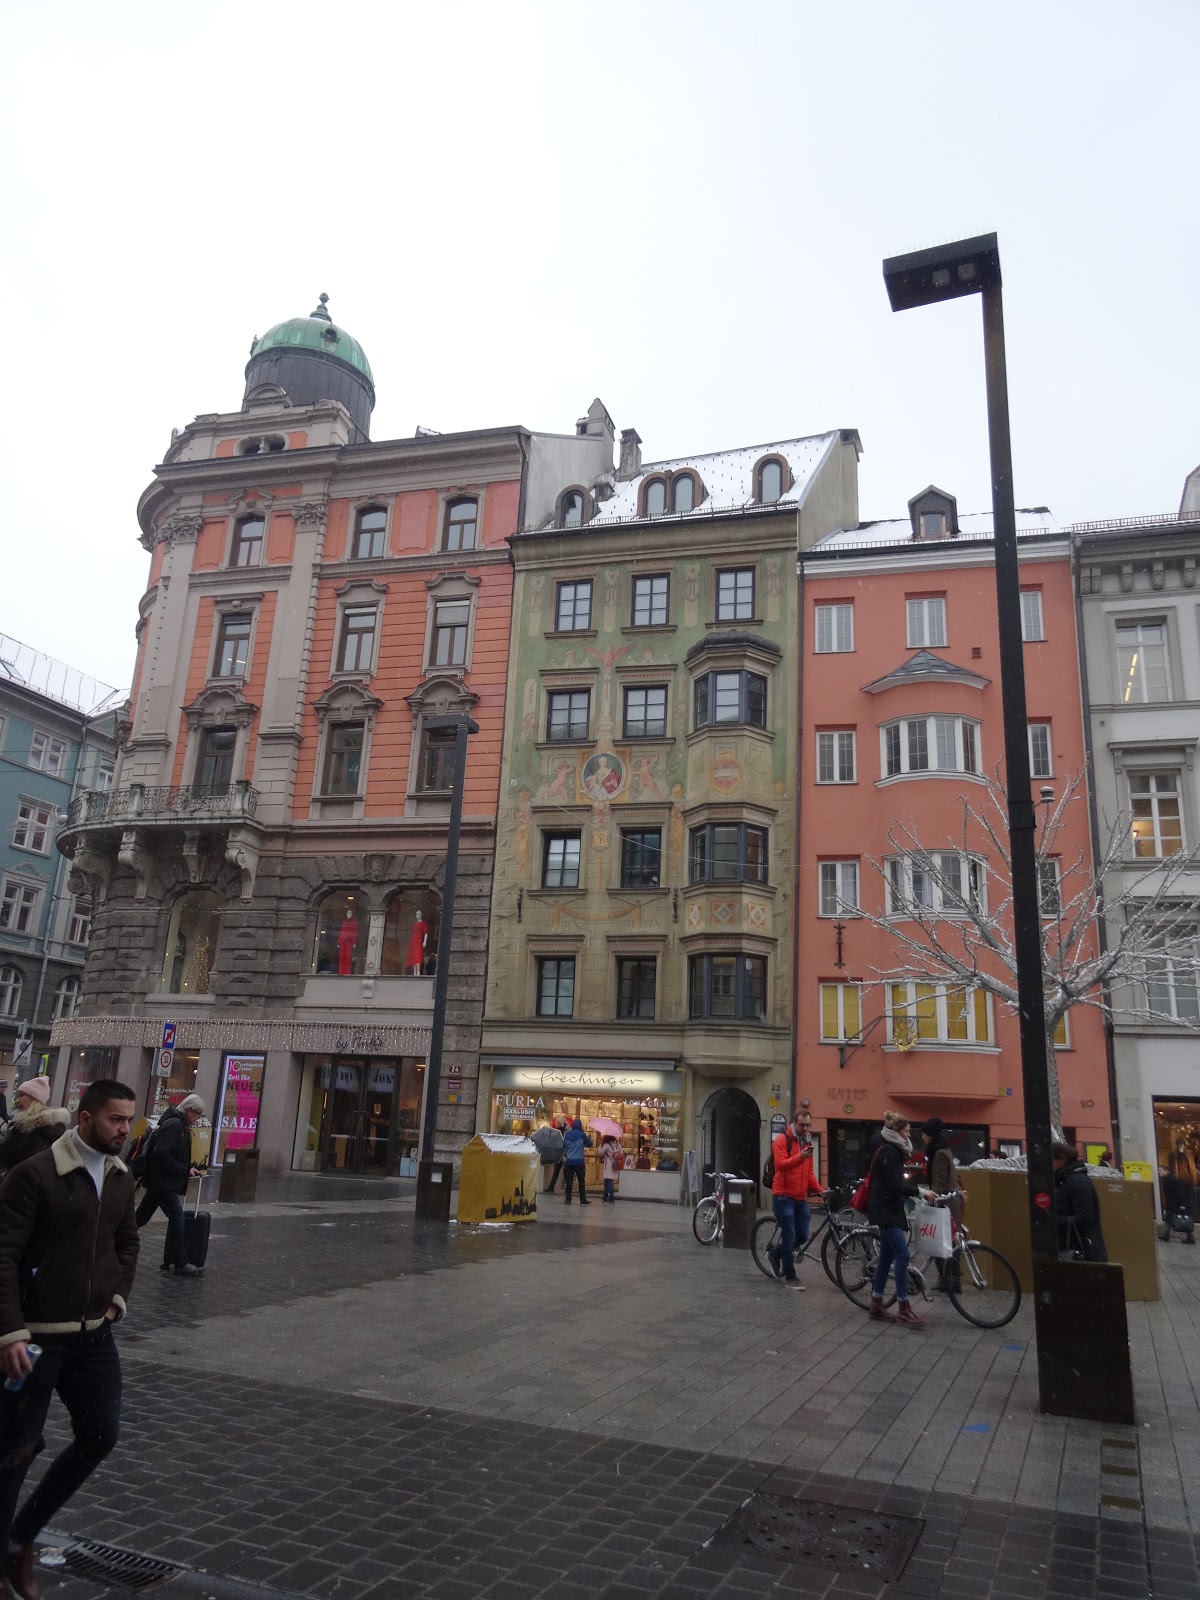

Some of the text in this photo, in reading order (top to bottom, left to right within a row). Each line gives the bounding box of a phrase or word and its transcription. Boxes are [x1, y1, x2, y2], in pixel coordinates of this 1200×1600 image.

[229, 1060, 241, 1071] 10
[227, 1081, 262, 1092] NEUES
[771, 1084, 781, 1092] 22
[496, 1094, 545, 1108] FURLA
[1080, 1099, 1095, 1108] 20
[221, 1116, 257, 1129] SALE
[919, 1222, 937, 1239] H&M
